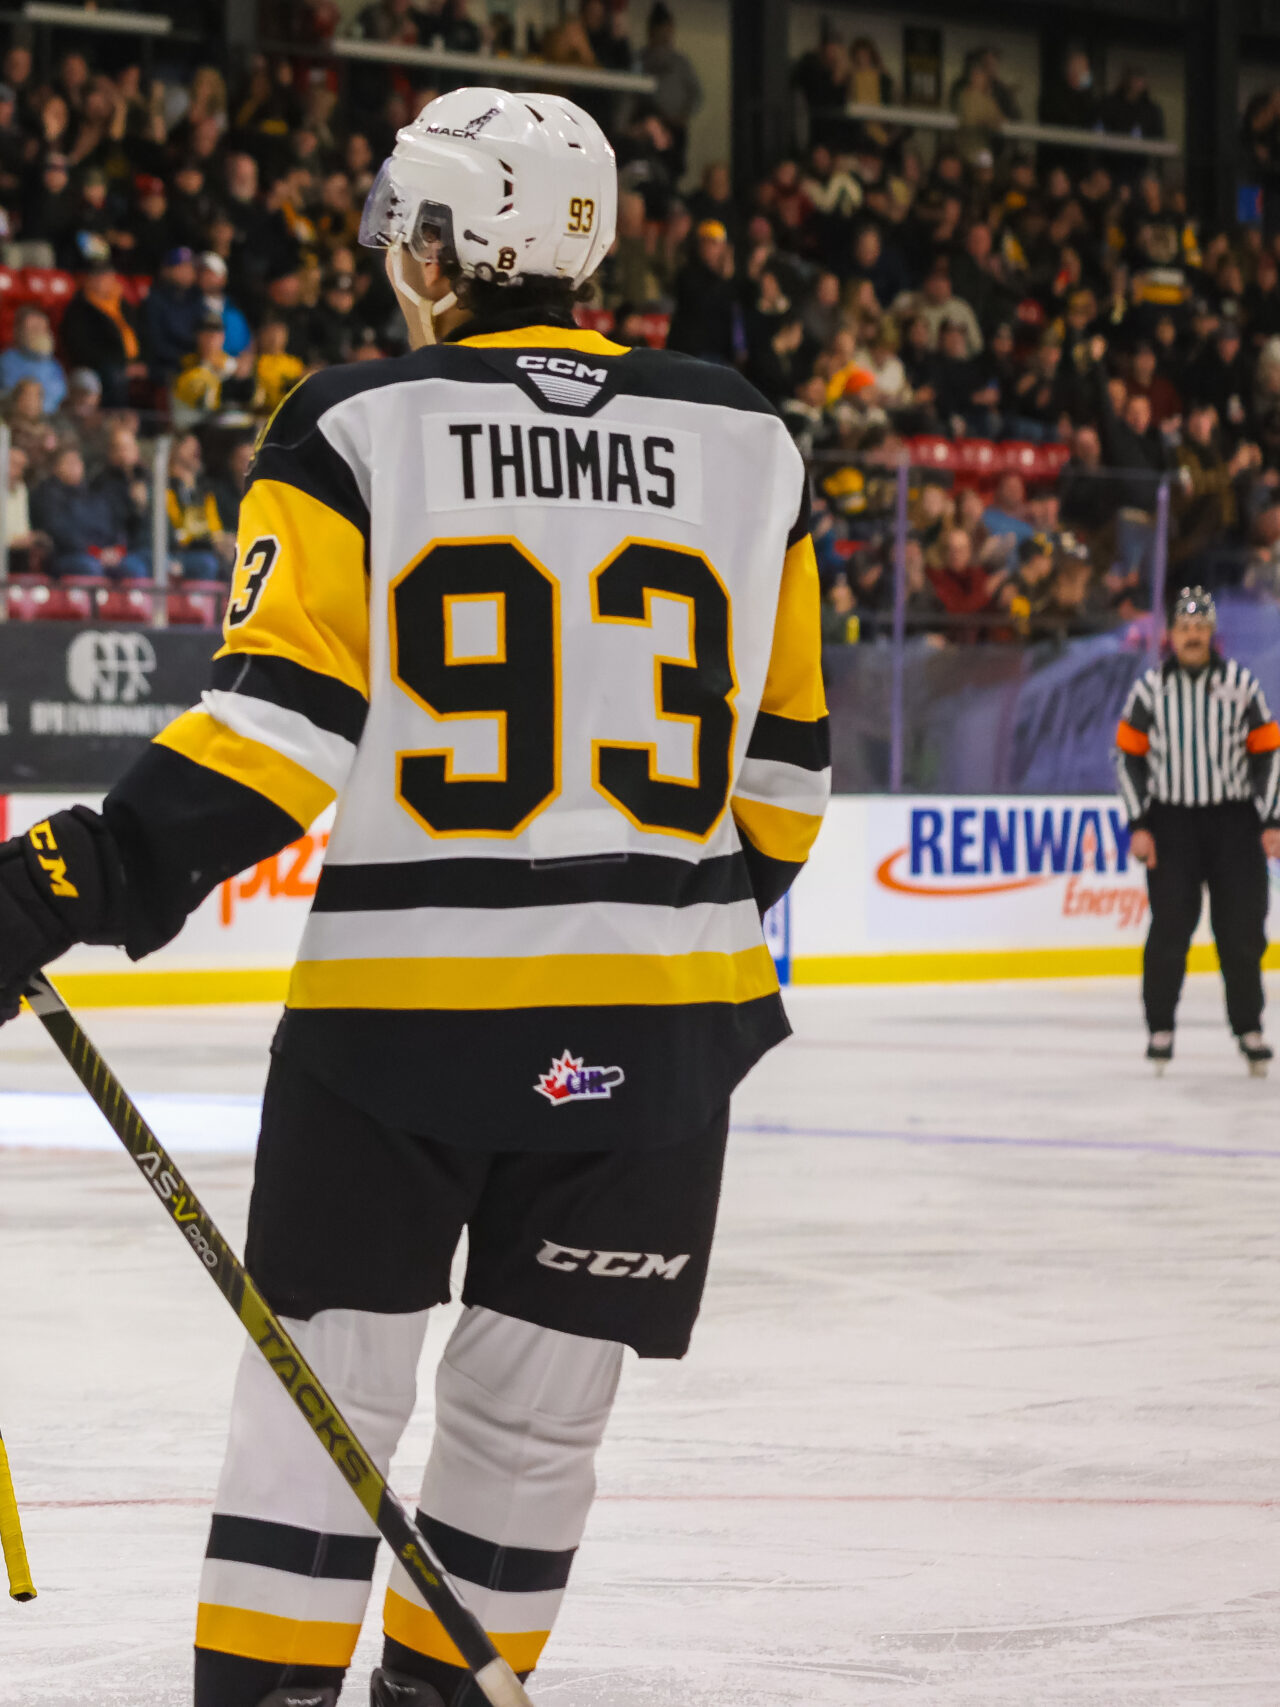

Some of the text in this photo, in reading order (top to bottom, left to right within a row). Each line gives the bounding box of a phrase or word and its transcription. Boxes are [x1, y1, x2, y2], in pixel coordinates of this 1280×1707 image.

[426, 126, 477, 141] MACK
[567, 197, 595, 234] 93
[497, 246, 517, 271] B
[515, 354, 609, 384] CCM
[448, 422, 676, 510] THOMAS
[228, 534, 283, 630] 3
[387, 534, 741, 844] 93
[910, 807, 1133, 876] RENWAY
[184, 1223, 218, 1268] PRO
[535, 1238, 692, 1280] CCM
[259, 1319, 371, 1486] TACKS
